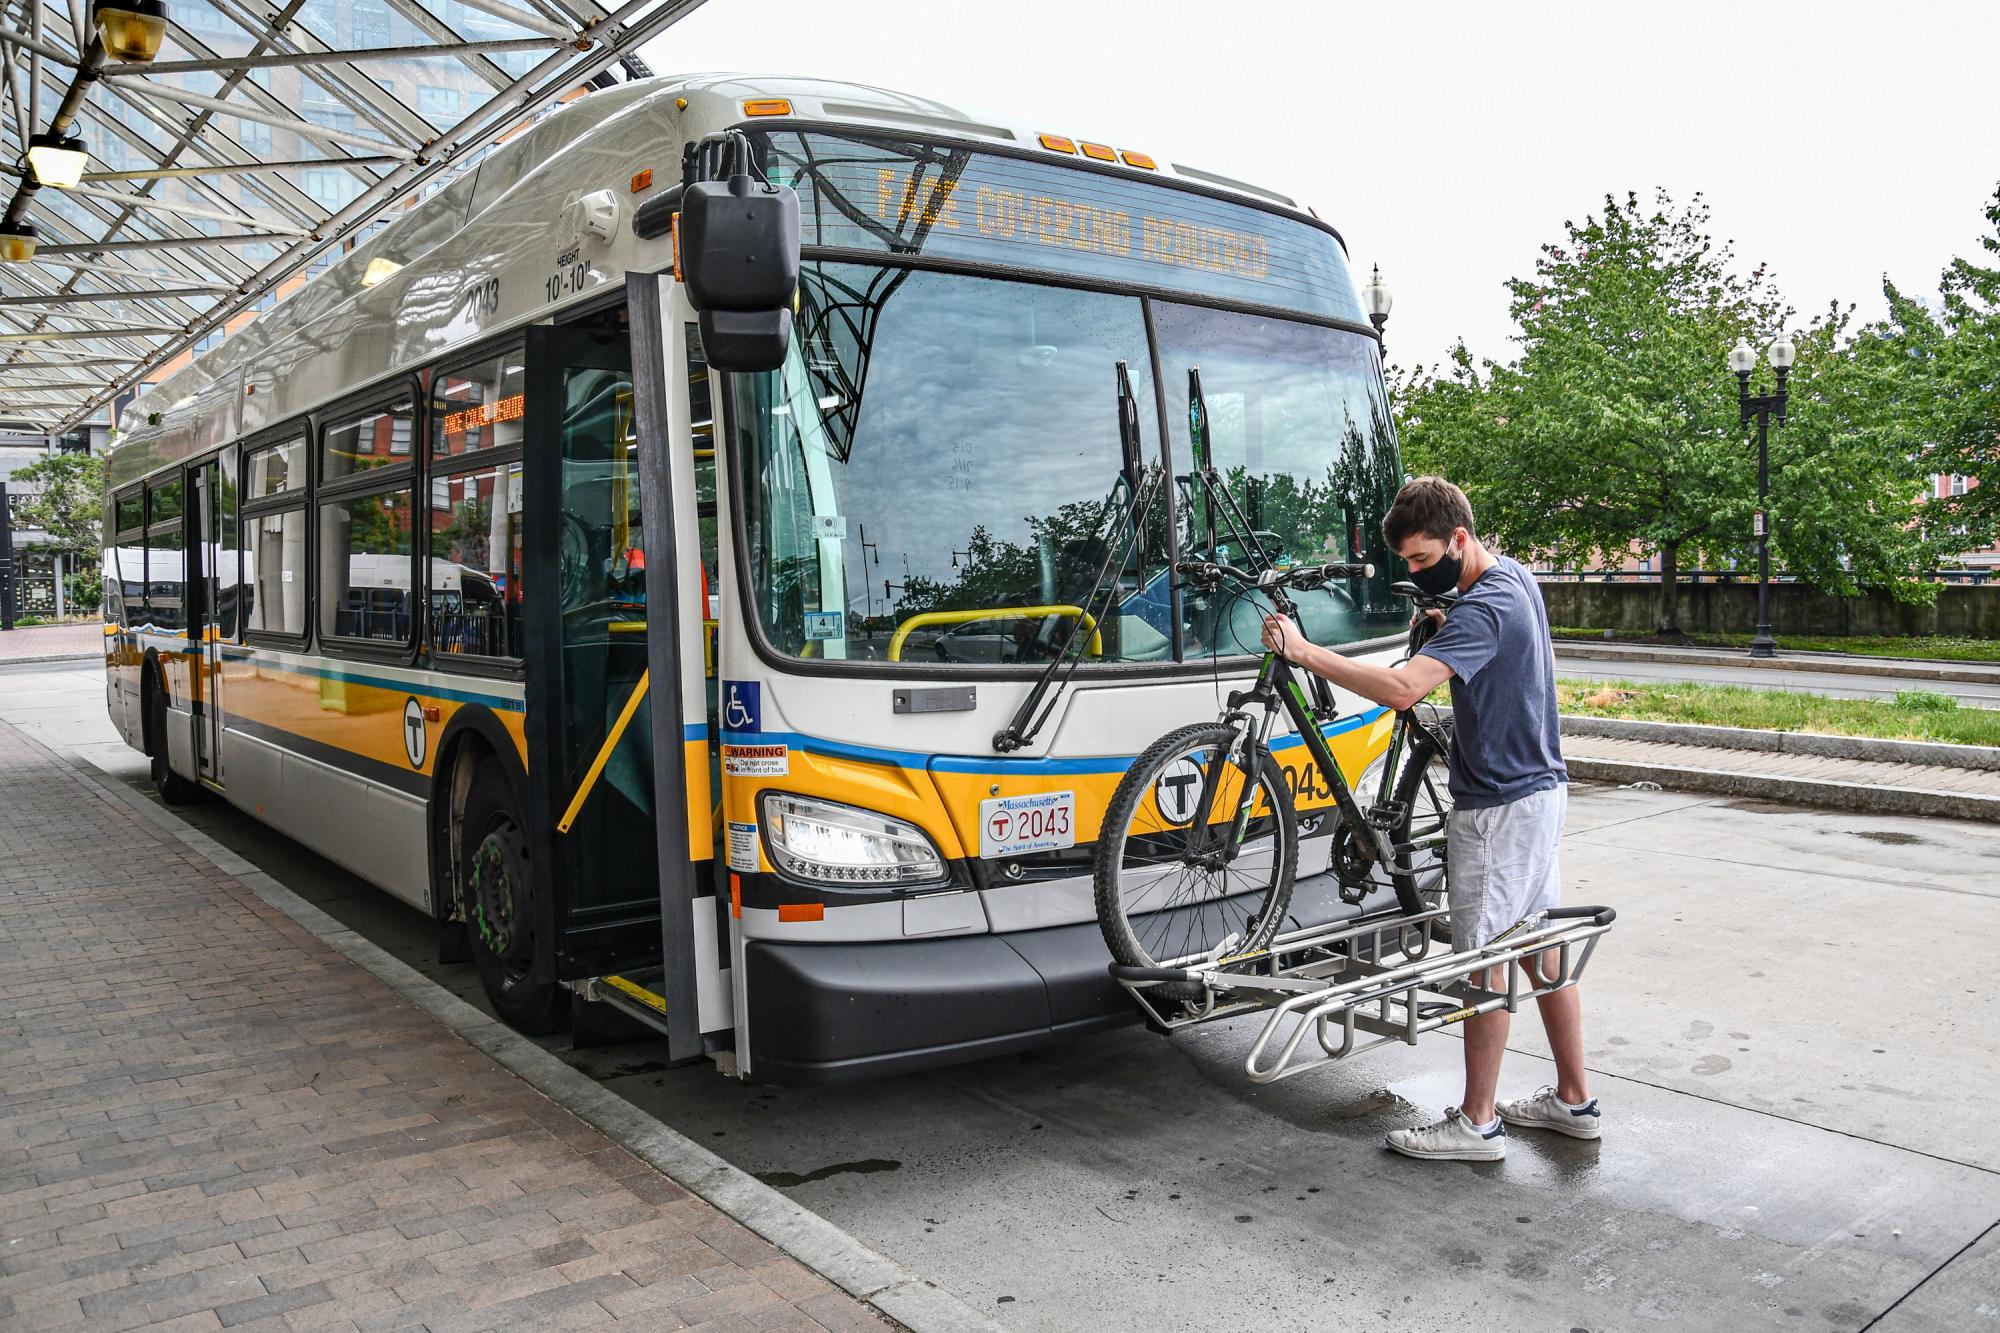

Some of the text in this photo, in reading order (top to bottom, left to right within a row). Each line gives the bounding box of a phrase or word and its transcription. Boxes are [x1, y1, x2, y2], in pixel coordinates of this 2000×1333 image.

[877, 168, 1268, 279] FACE COVERING REQUIRED
[557, 249, 580, 268] HEIGHT
[546, 260, 591, 303] 10'-10"
[464, 277, 499, 324] 2043
[730, 746, 784, 757] WARNING
[1262, 763, 1331, 807] 043
[1003, 796, 1055, 810] Massachusetts
[1019, 807, 1069, 840] 2043
[1013, 843, 1026, 851] Spirit
